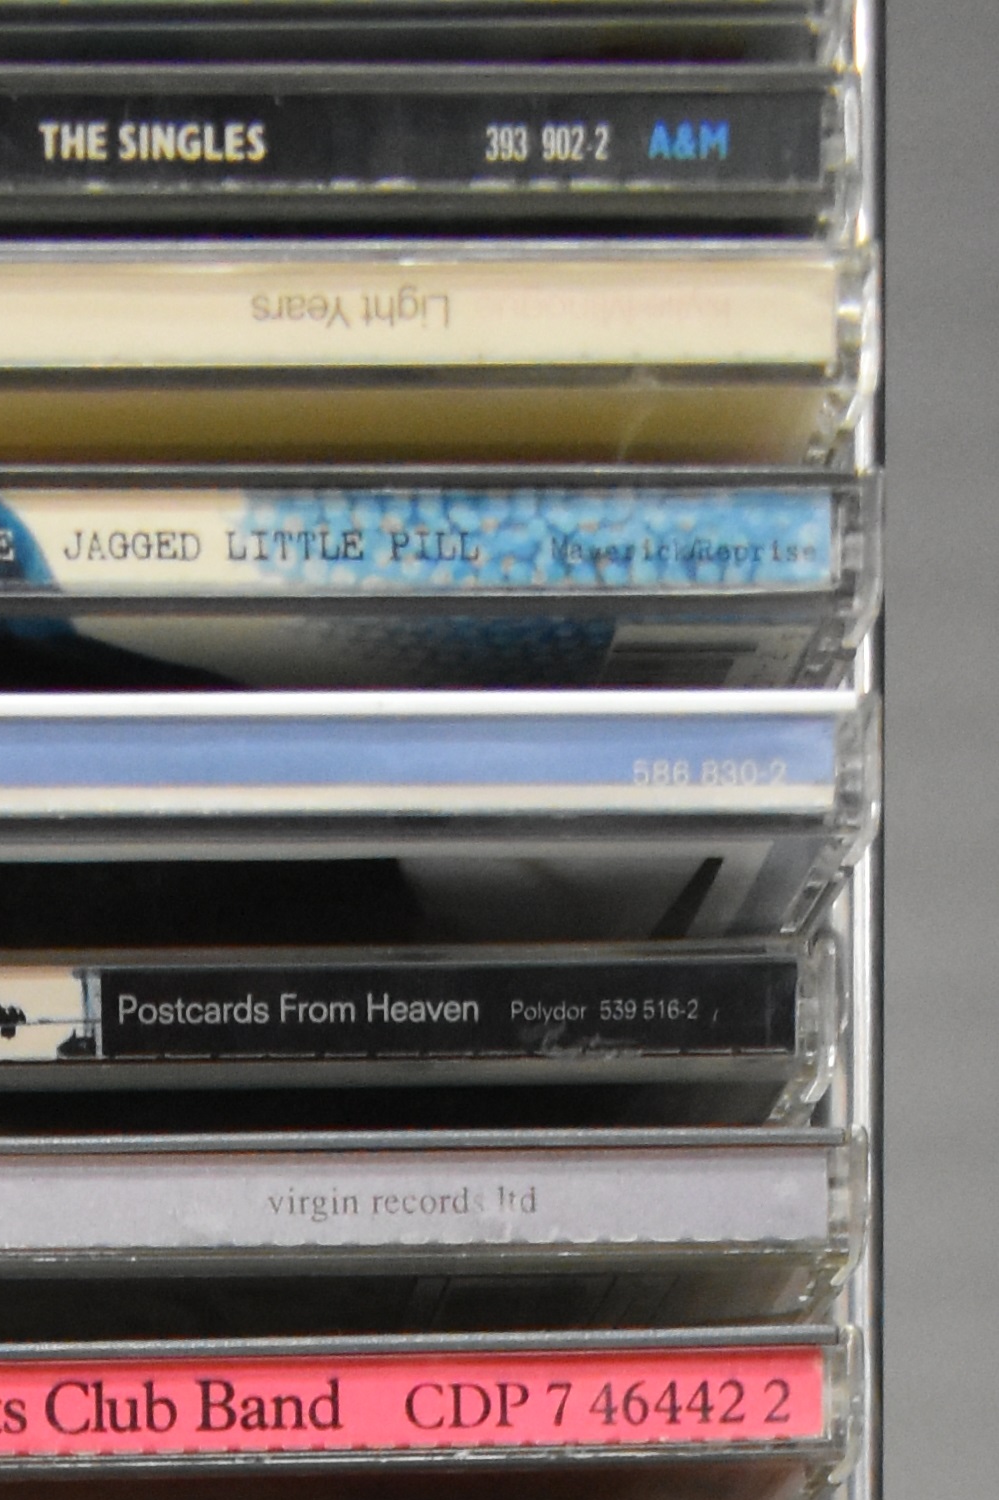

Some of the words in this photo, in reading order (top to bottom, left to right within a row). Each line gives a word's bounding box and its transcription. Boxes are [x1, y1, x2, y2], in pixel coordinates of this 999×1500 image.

[40, 122, 108, 161] THE
[118, 122, 267, 162] SINGLES
[485, 123, 527, 160] 393
[541, 124, 609, 160] 902-2
[648, 121, 729, 159] A&M
[250, 292, 350, 328] Years
[361, 288, 450, 328] Light
[64, 529, 201, 562] JAGGED
[226, 530, 364, 562] LITTLE
[389, 530, 481, 562] PILL
[633, 759, 690, 785] 586
[701, 758, 787, 784] 830-2
[117, 995, 270, 1026] Postcards
[279, 994, 356, 1024] From
[367, 994, 479, 1024] Heaven
[510, 999, 586, 1026] Polydor
[599, 999, 635, 1023] 539
[642, 999, 699, 1022] 516-2
[268, 1190, 360, 1223] virgin
[46, 1378, 178, 1434] Club
[193, 1377, 343, 1432] Band
[403, 1382, 530, 1429] CDP
[545, 1382, 574, 1425] 7
[588, 1380, 746, 1425] 46442
[764, 1378, 792, 1423] 2
